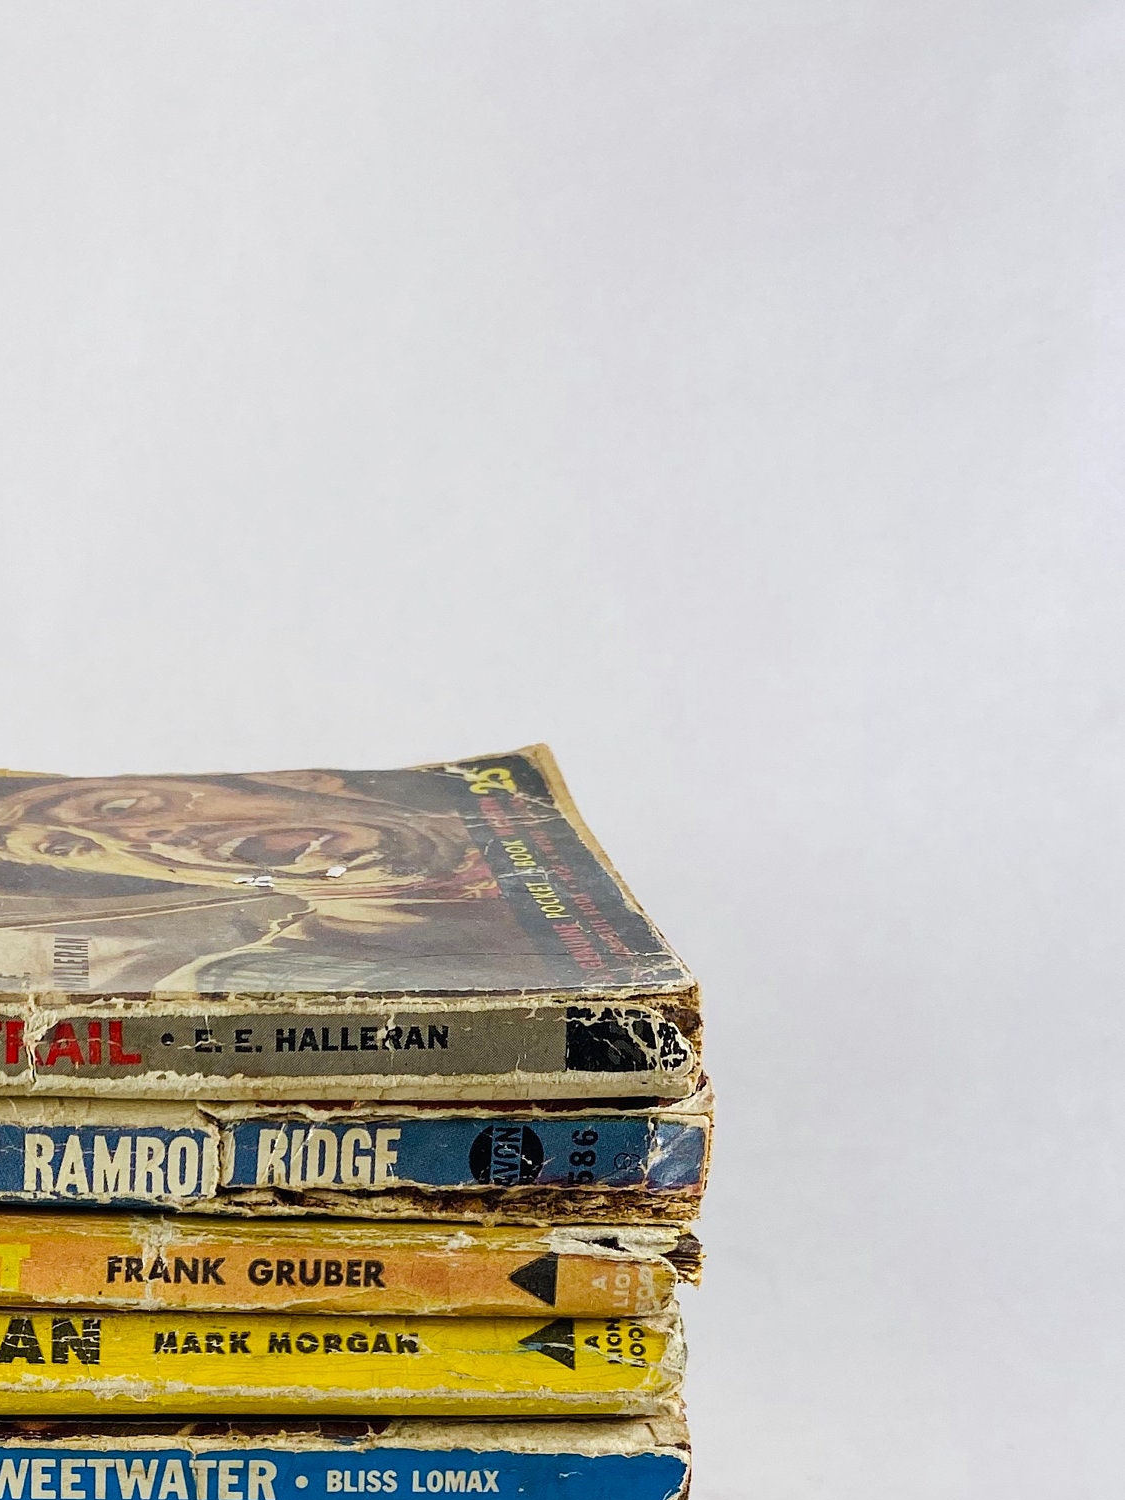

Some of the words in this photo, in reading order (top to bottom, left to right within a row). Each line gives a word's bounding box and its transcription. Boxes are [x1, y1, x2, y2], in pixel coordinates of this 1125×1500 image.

[500, 839, 538, 867] BOOK
[524, 881, 573, 920] POCKET
[53, 937, 92, 988] HALLERAN
[195, 1028, 222, 1054] E.
[235, 1028, 263, 1054] E.
[275, 1024, 450, 1053] HALLERAN
[256, 1127, 402, 1187] RIDGE
[106, 1254, 227, 1286] FRANK
[248, 1257, 386, 1289] GRUBER
[153, 1331, 252, 1356] MARK
[267, 1331, 421, 1356] MORGAN
[584, 1335, 600, 1350] A
[325, 1469, 398, 1495] BLISS
[411, 1469, 501, 1495] LOMAX
